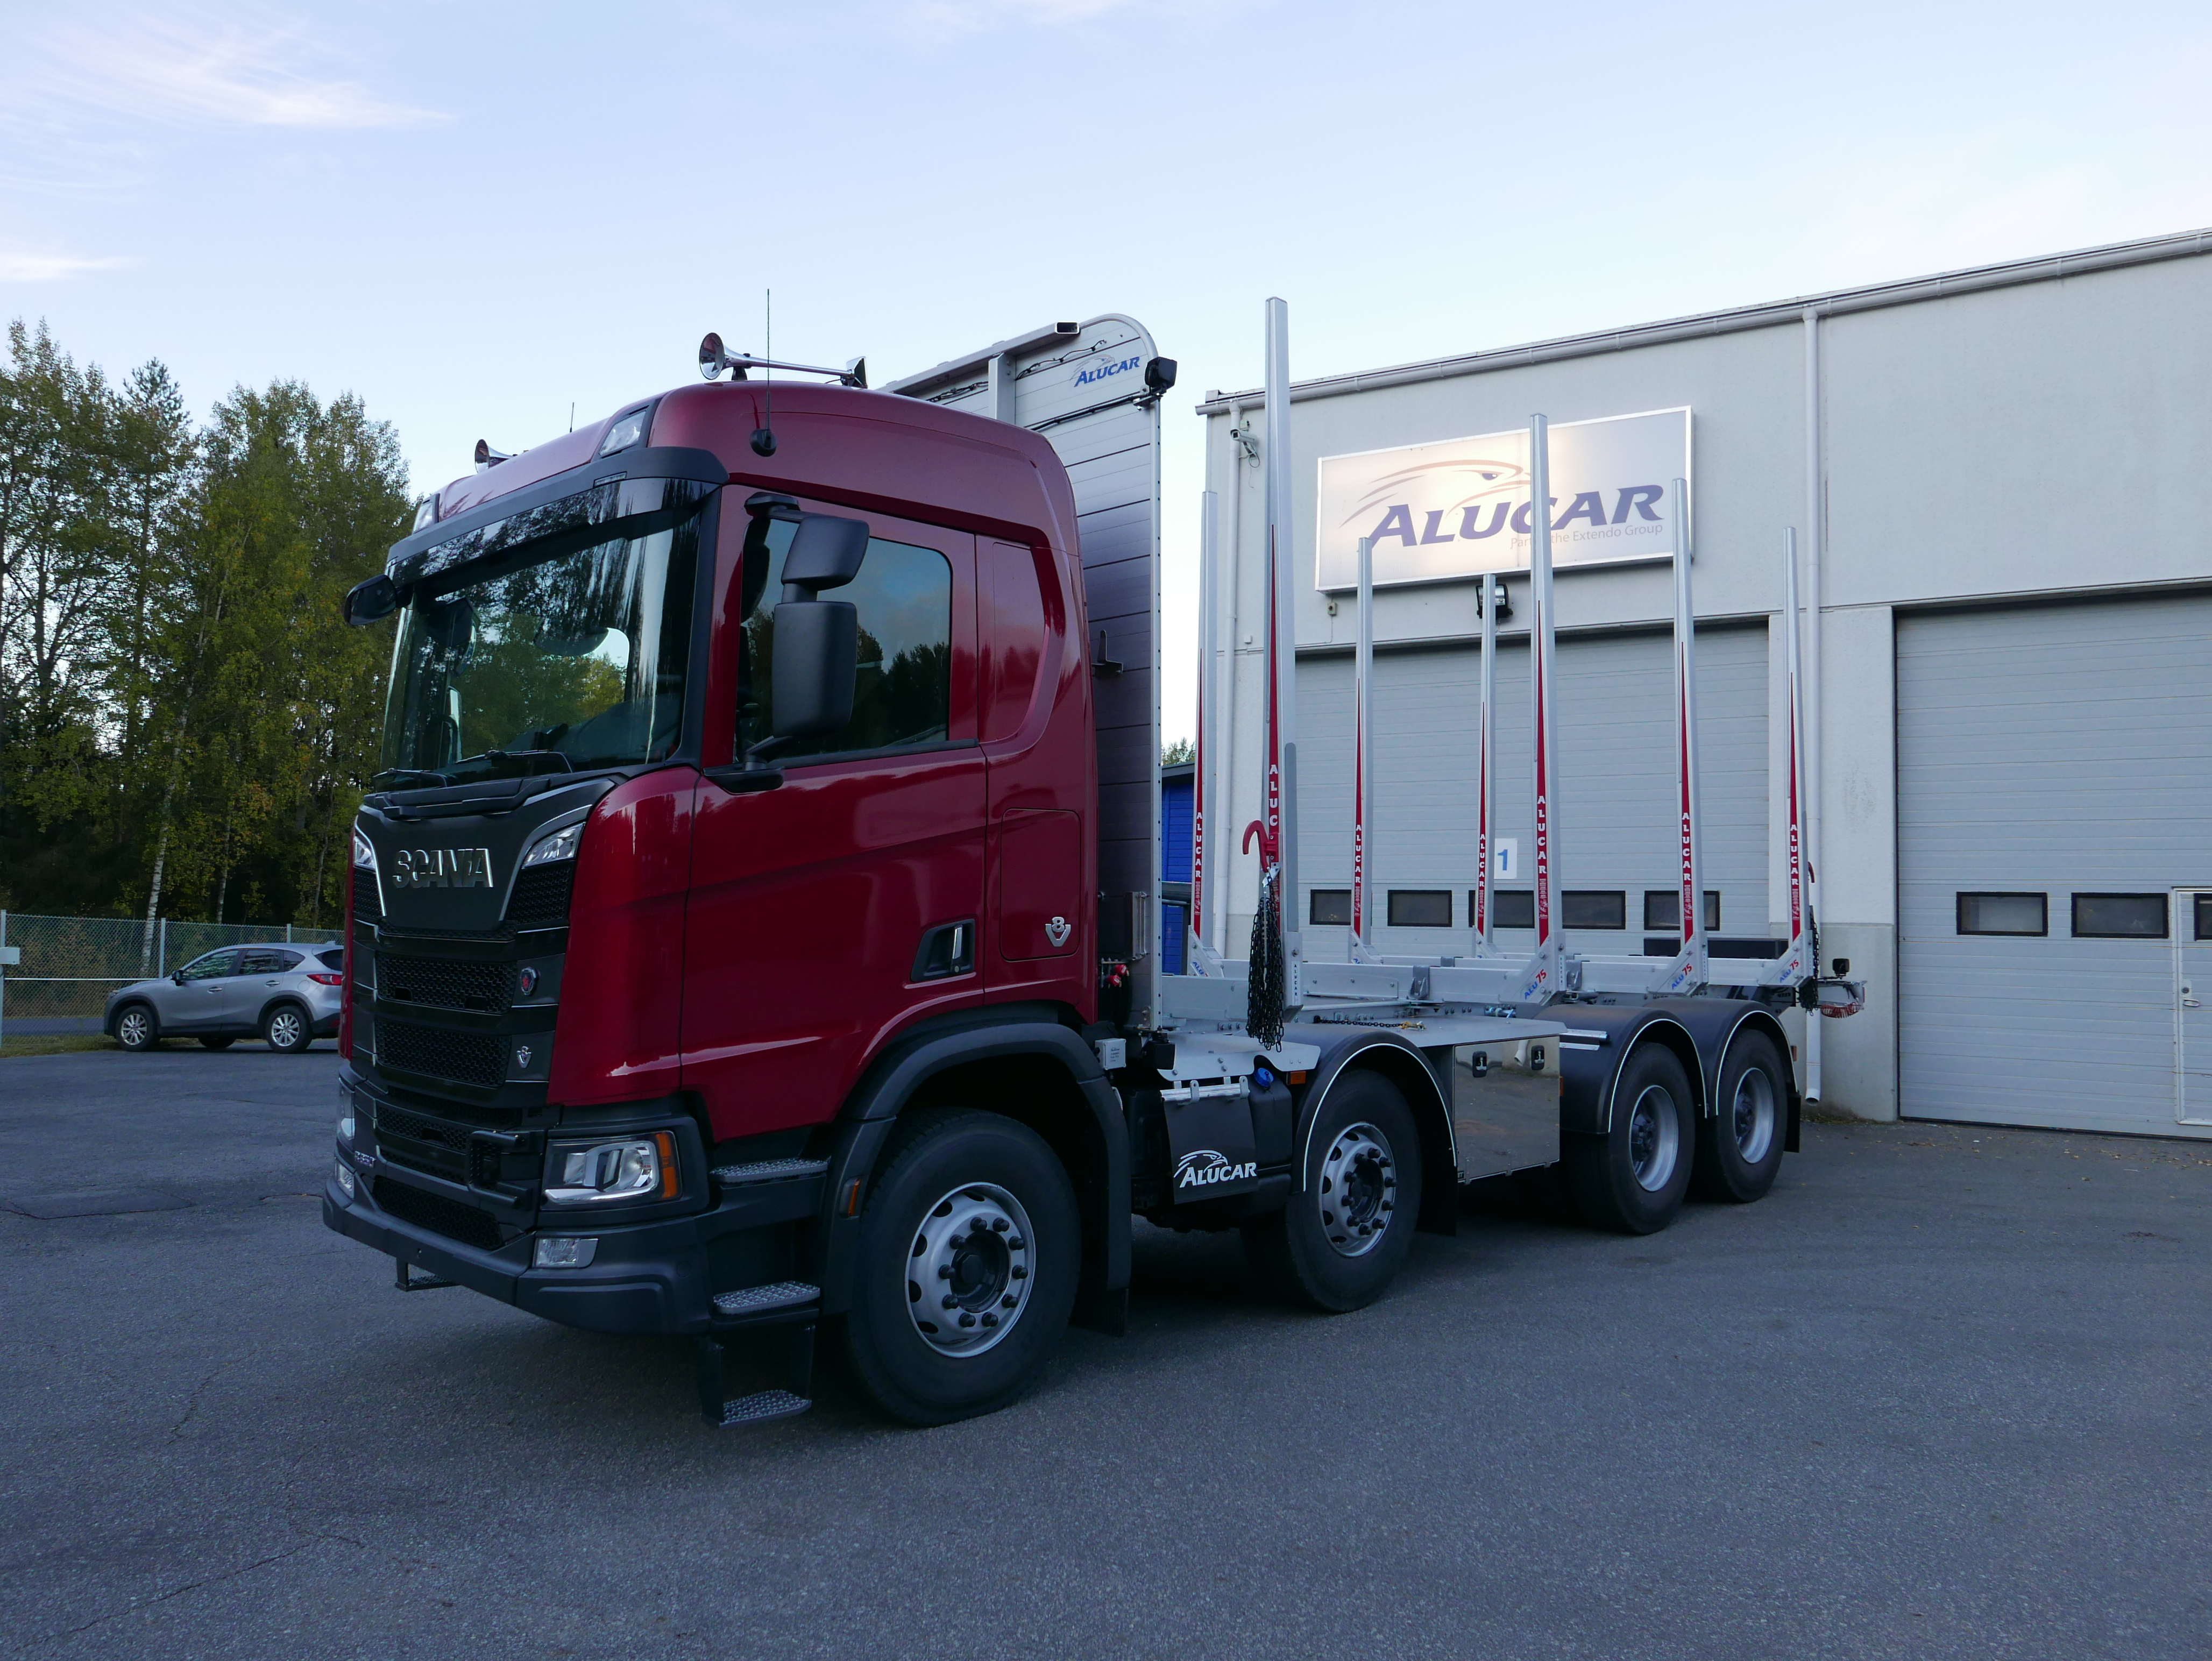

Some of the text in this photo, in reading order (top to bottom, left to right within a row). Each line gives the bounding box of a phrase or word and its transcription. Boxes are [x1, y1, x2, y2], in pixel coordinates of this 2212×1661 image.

[1073, 356, 1140, 388] ALUCAR
[1356, 484, 1665, 552] ALUCAR
[1510, 537, 1532, 549] Par
[1573, 527, 1622, 542] Extendo
[1625, 524, 1663, 536] Group
[1269, 764, 1279, 827] ALUC
[1195, 812, 1203, 878] ALUCAR
[1497, 849, 1508, 871] 1
[1537, 796, 1547, 874] ALUCAR
[1682, 812, 1692, 881] ALUCAR
[1789, 824, 1799, 885] ALUCAR
[392, 848, 494, 888] SCANIA
[1179, 1162, 1257, 1189] ALUCAR
